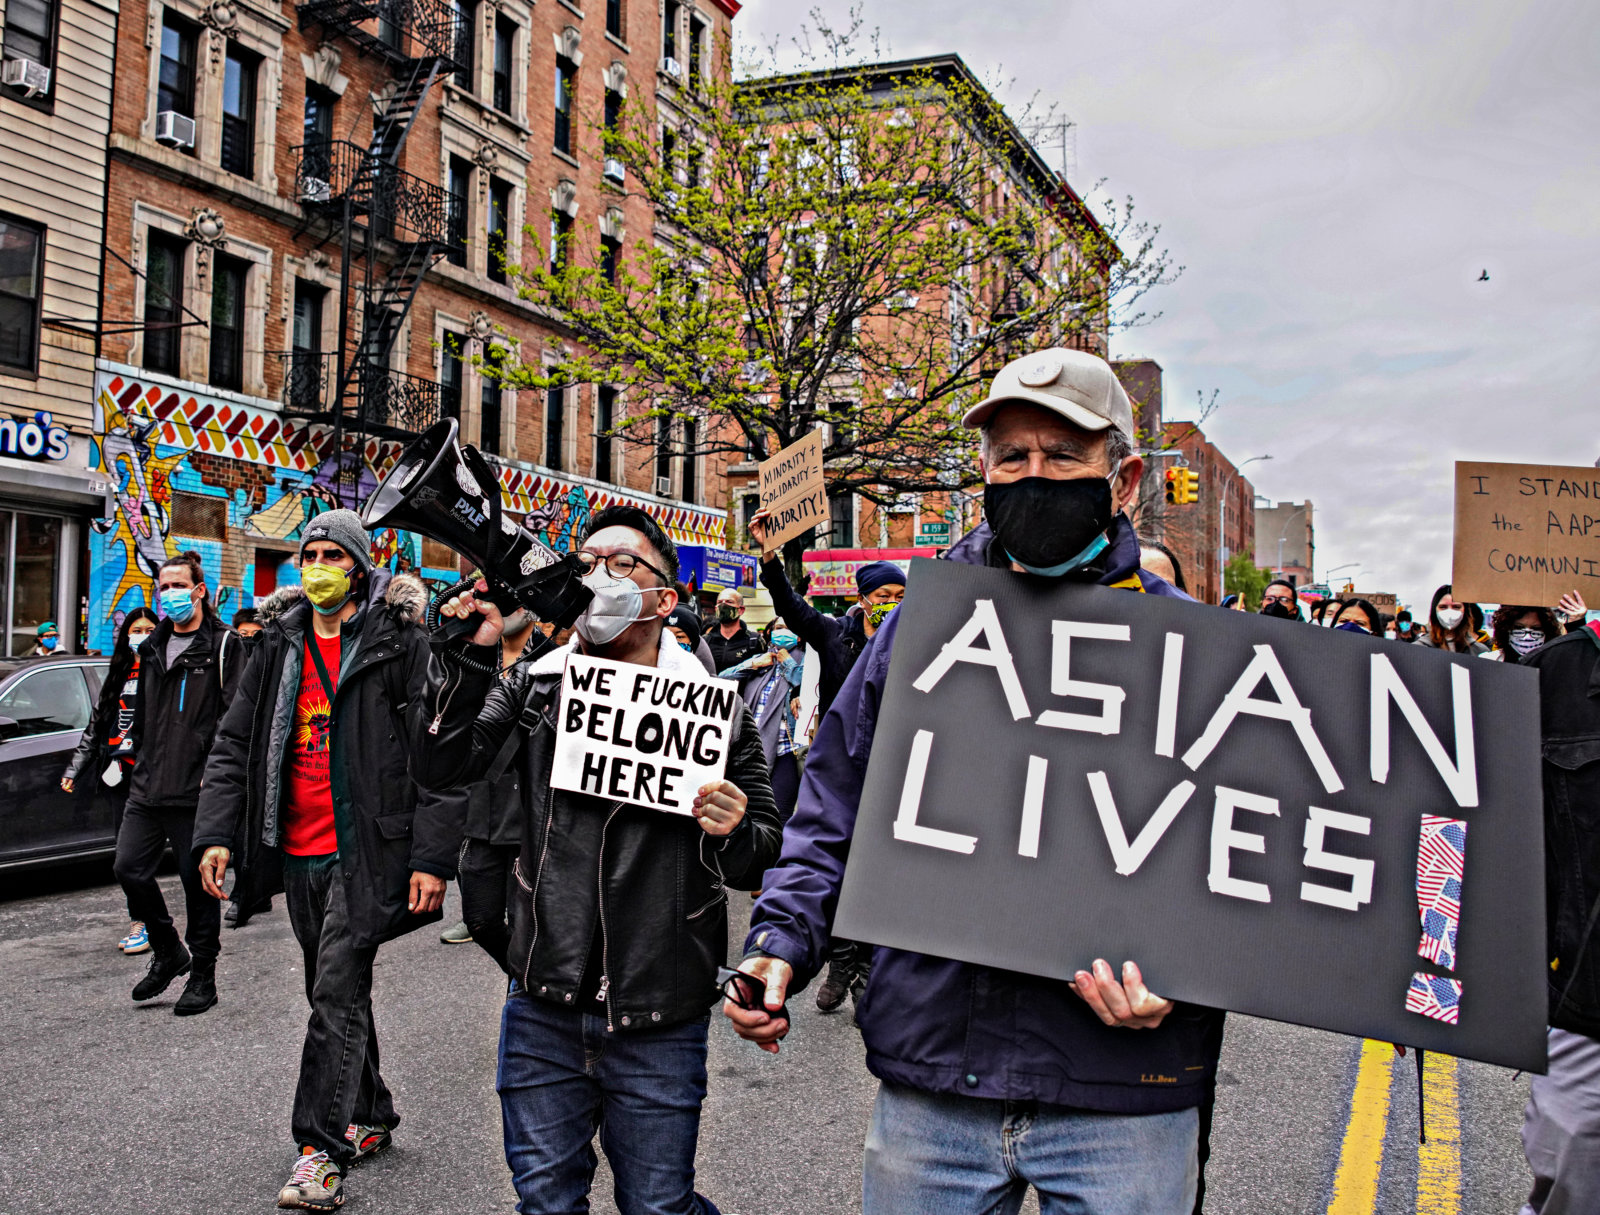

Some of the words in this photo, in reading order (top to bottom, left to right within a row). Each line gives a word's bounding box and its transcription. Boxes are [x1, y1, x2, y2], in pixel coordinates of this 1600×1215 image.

[762, 466, 809, 508] SOLIDARITY
[764, 448, 806, 489] MINORITY
[1469, 476, 1490, 495] I
[764, 491, 825, 539] MAJORITY!
[1491, 512, 1524, 531] the
[1488, 549, 1600, 578] COMMUNI
[569, 665, 617, 697] WE
[630, 673, 736, 721] FUCKIN
[913, 599, 1479, 808] ASIAN
[565, 698, 723, 767] BELONG
[580, 752, 684, 808] HERE
